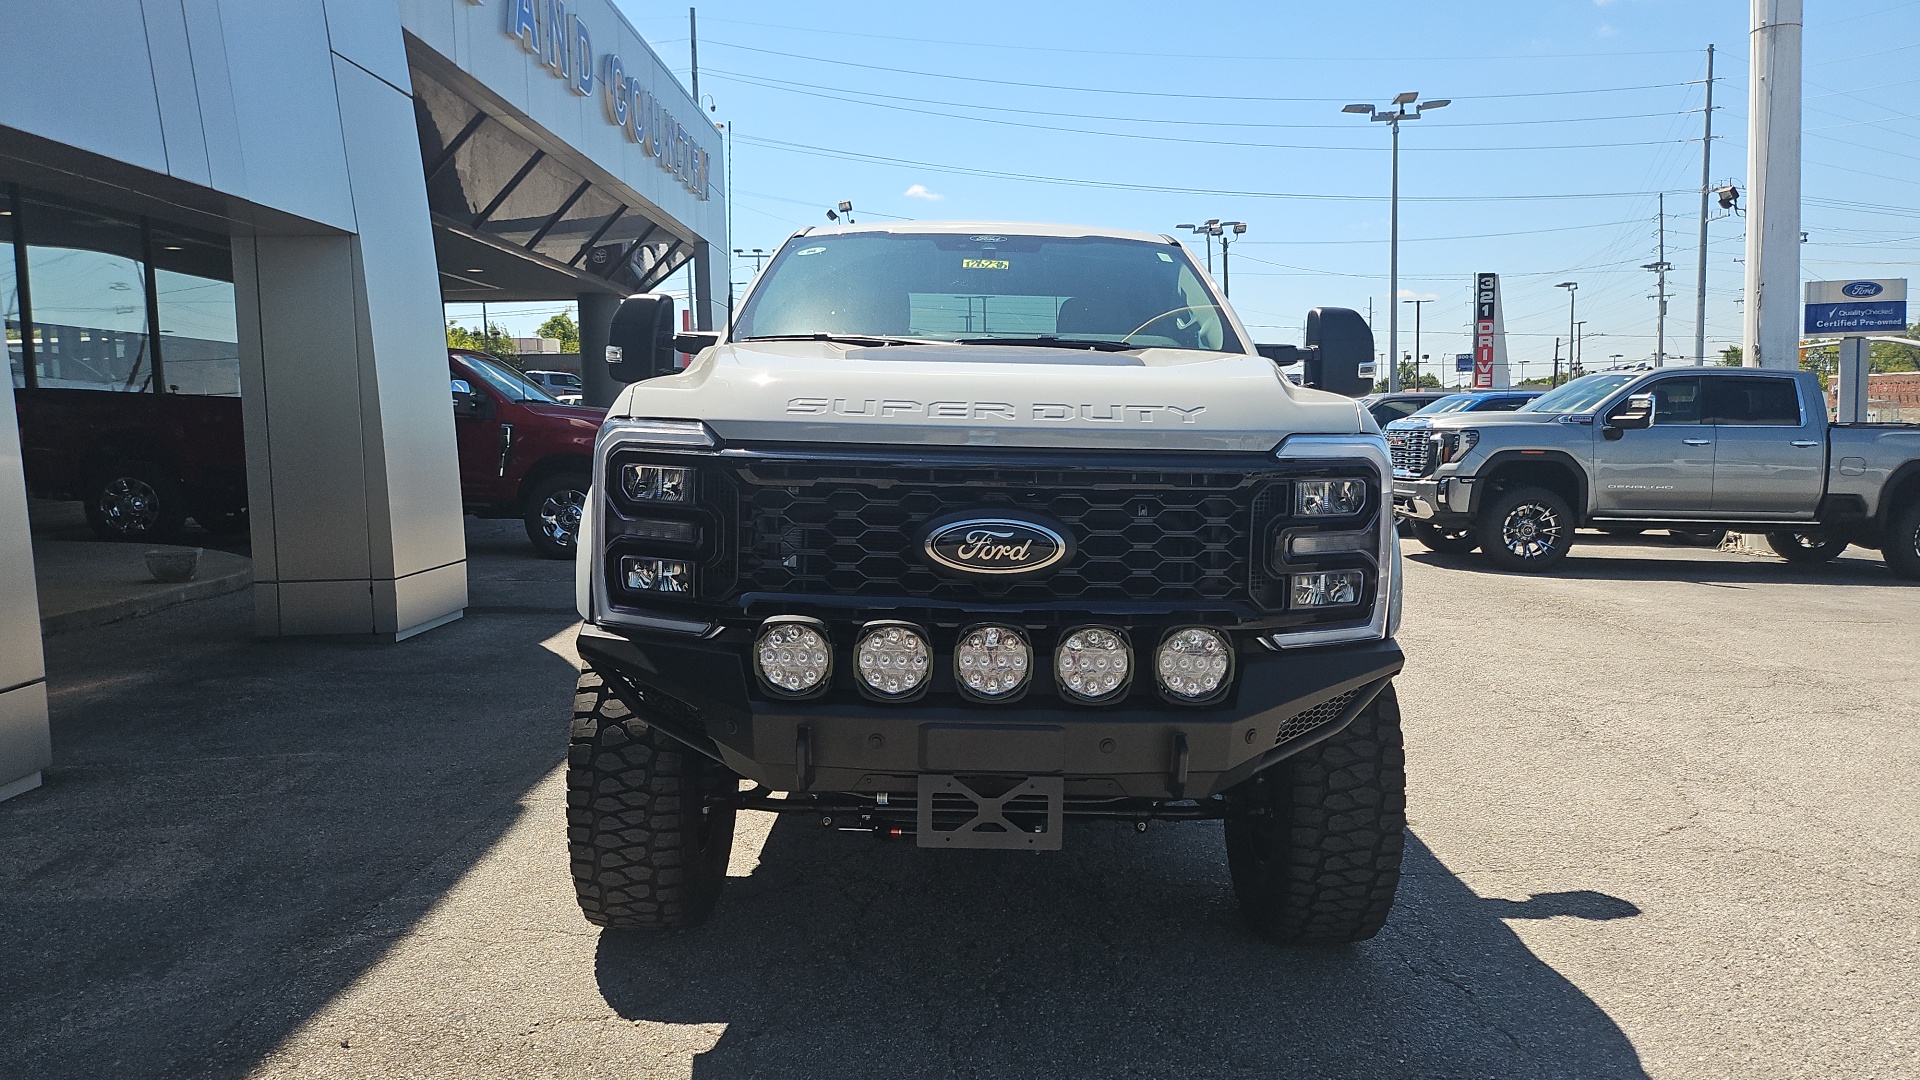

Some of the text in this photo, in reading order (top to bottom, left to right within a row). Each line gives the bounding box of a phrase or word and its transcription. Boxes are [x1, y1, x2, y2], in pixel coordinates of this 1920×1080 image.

[507, 0, 711, 202] AND COUNTRY
[1851, 284, 1876, 295] Ford
[1816, 318, 1902, 328] Certified Pre-owned
[1838, 309, 1893, 317] QualityChecked
[1477, 322, 1494, 386] DRIVE
[786, 397, 1207, 424] SUPER DUTY
[957, 529, 1032, 561] Ford
